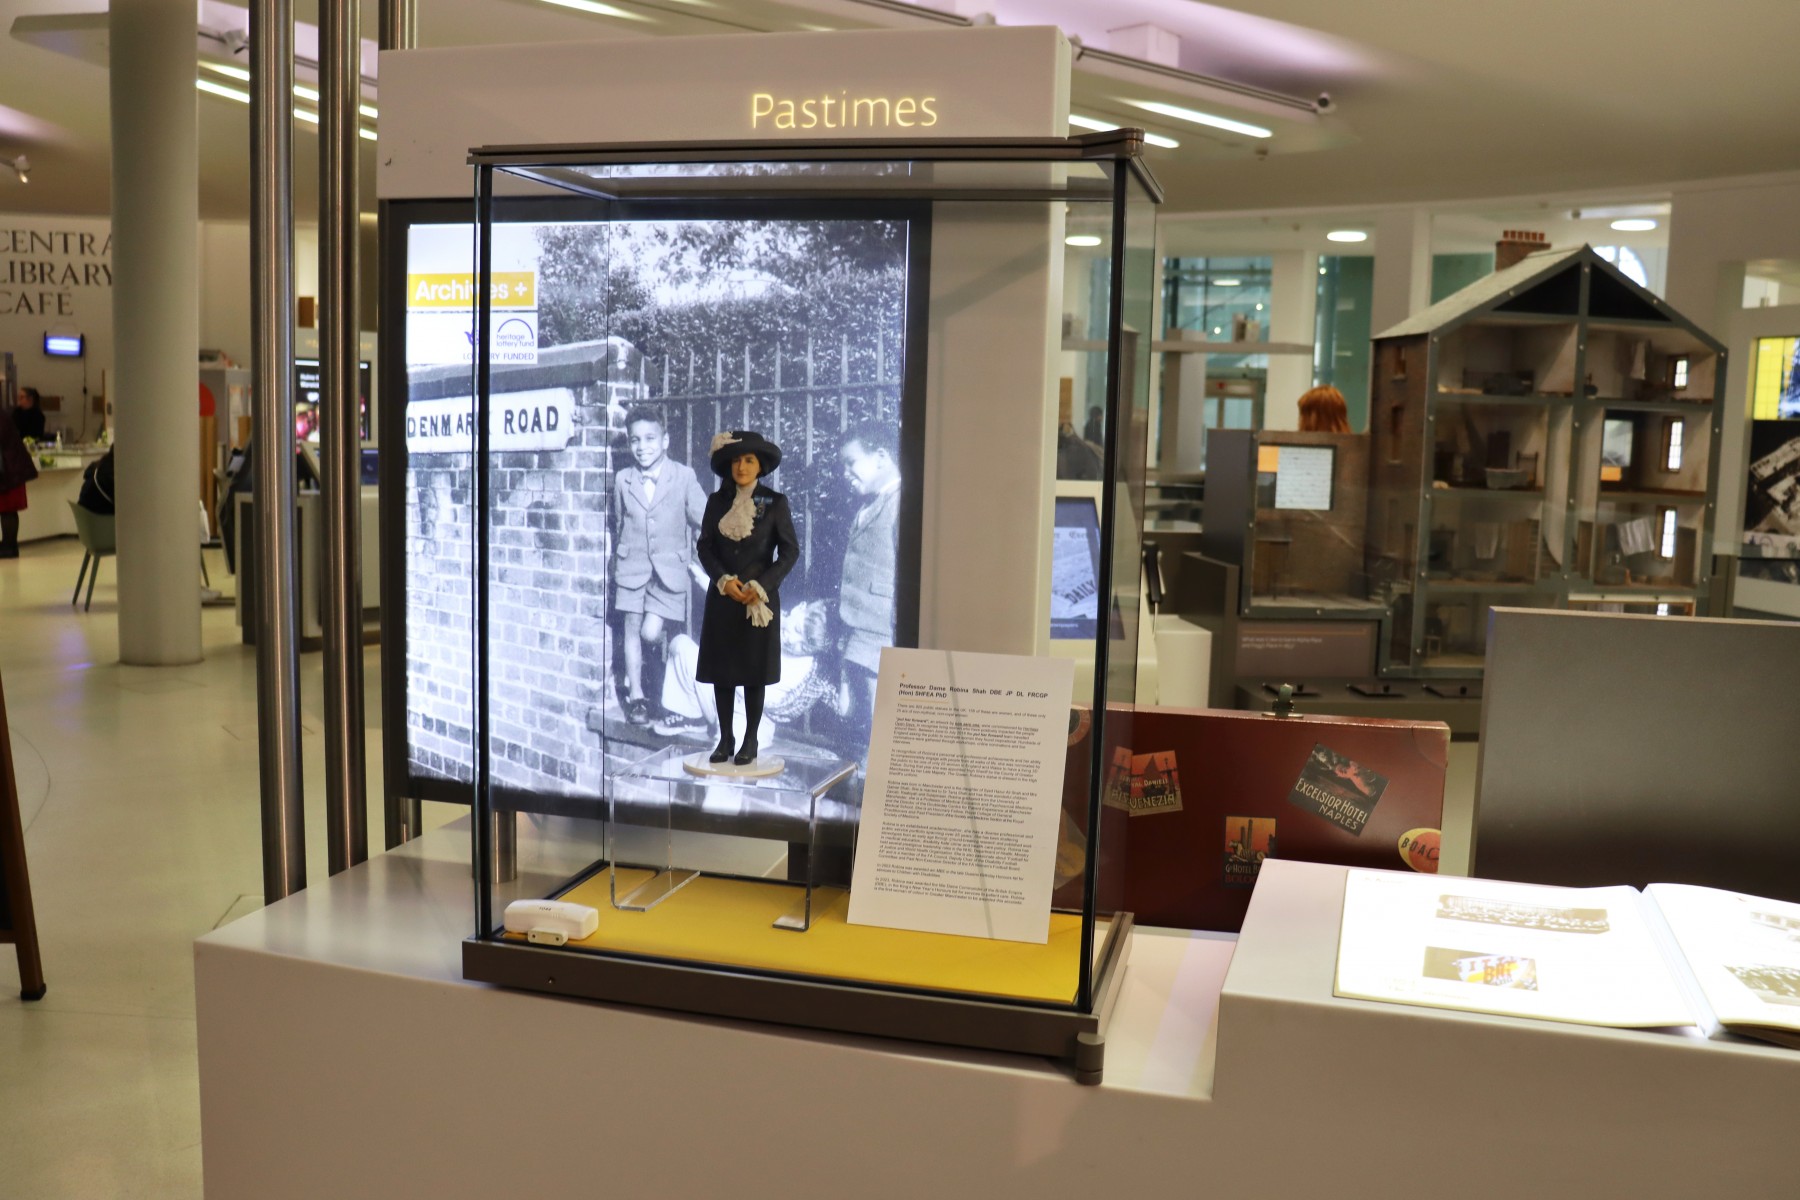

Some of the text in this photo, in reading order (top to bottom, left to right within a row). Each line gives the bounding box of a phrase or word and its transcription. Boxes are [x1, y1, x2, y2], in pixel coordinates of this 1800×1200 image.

[752, 90, 938, 129] Pastimes
[497, 340, 517, 348] lottery
[407, 405, 559, 438] DENMAR ROAD
[1065, 579, 1096, 604] DAILY
[899, 682, 925, 690] Professor
[1129, 794, 1175, 810] VENEZIA
[1295, 778, 1368, 824] EXCELSIOR HOTEL
[1318, 804, 1358, 830] NAPLES
